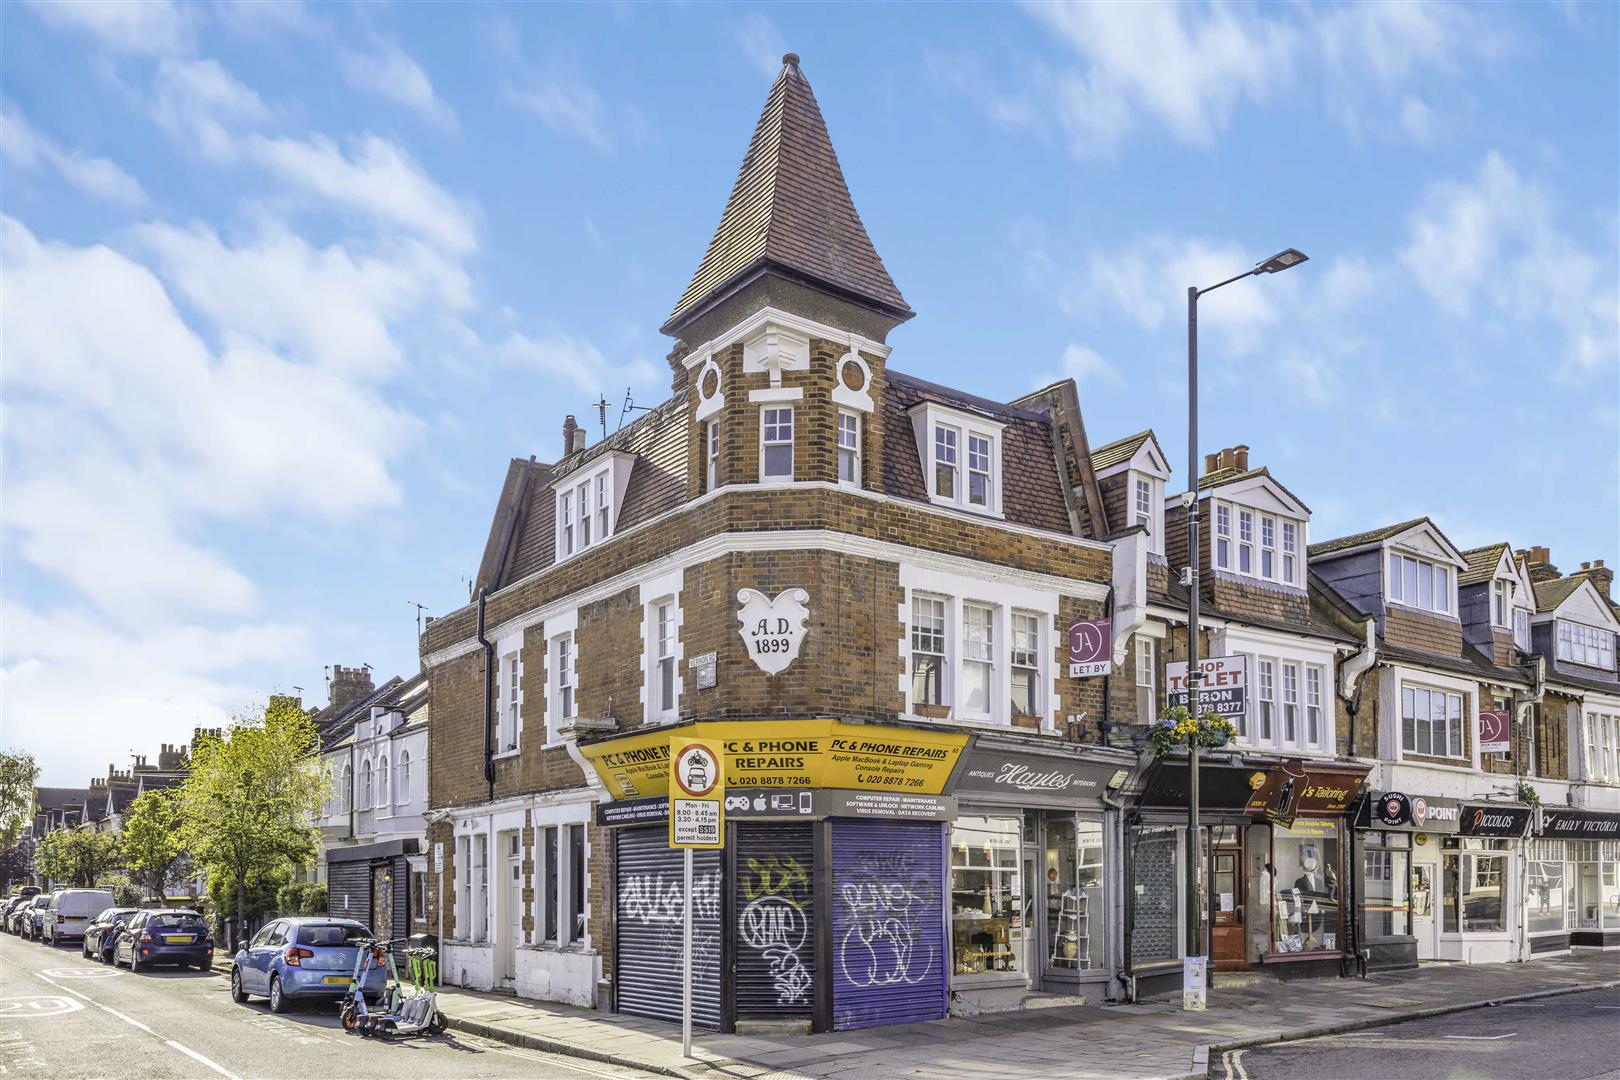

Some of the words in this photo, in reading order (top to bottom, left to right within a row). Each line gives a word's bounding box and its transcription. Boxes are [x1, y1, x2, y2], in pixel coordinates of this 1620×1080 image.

[751, 618, 793, 636] A.D.
[755, 638, 790, 654] 1899
[1071, 632, 1094, 653] JA
[1073, 665, 1091, 675] LET
[1094, 664, 1106, 673] BY
[1203, 670, 1242, 687] LET
[1179, 690, 1232, 705] BRON
[1217, 701, 1242, 712] 8377
[742, 742, 754, 752] &
[758, 741, 818, 752] PHONE
[830, 739, 848, 750] PC
[848, 741, 857, 751] &
[859, 742, 902, 754] PHONE
[902, 746, 948, 759] REPAIRS
[601, 753, 617, 766] PC
[624, 747, 661, 763] PHONE
[735, 757, 804, 768] REPAIRS
[831, 754, 851, 762] Apple
[888, 759, 909, 767] Laptop
[910, 761, 934, 770] Gaming
[855, 764, 881, 772] Console
[881, 766, 905, 774] Repairs
[968, 770, 995, 778] ANTIQUES
[788, 776, 811, 784] 7266
[866, 775, 882, 783] 020
[883, 776, 903, 785] 8878
[905, 778, 924, 787] 7266
[1072, 779, 1097, 788] INTERIORS
[1315, 786, 1348, 801] Tailoring
[1384, 793, 1404, 802] SUSHI
[1429, 807, 1457, 820] POINT
[1472, 809, 1514, 830] PICCOLOS
[1384, 817, 1402, 825] POINT
[1554, 819, 1582, 831] EMILY
[1583, 820, 1619, 832] VICTORIA
